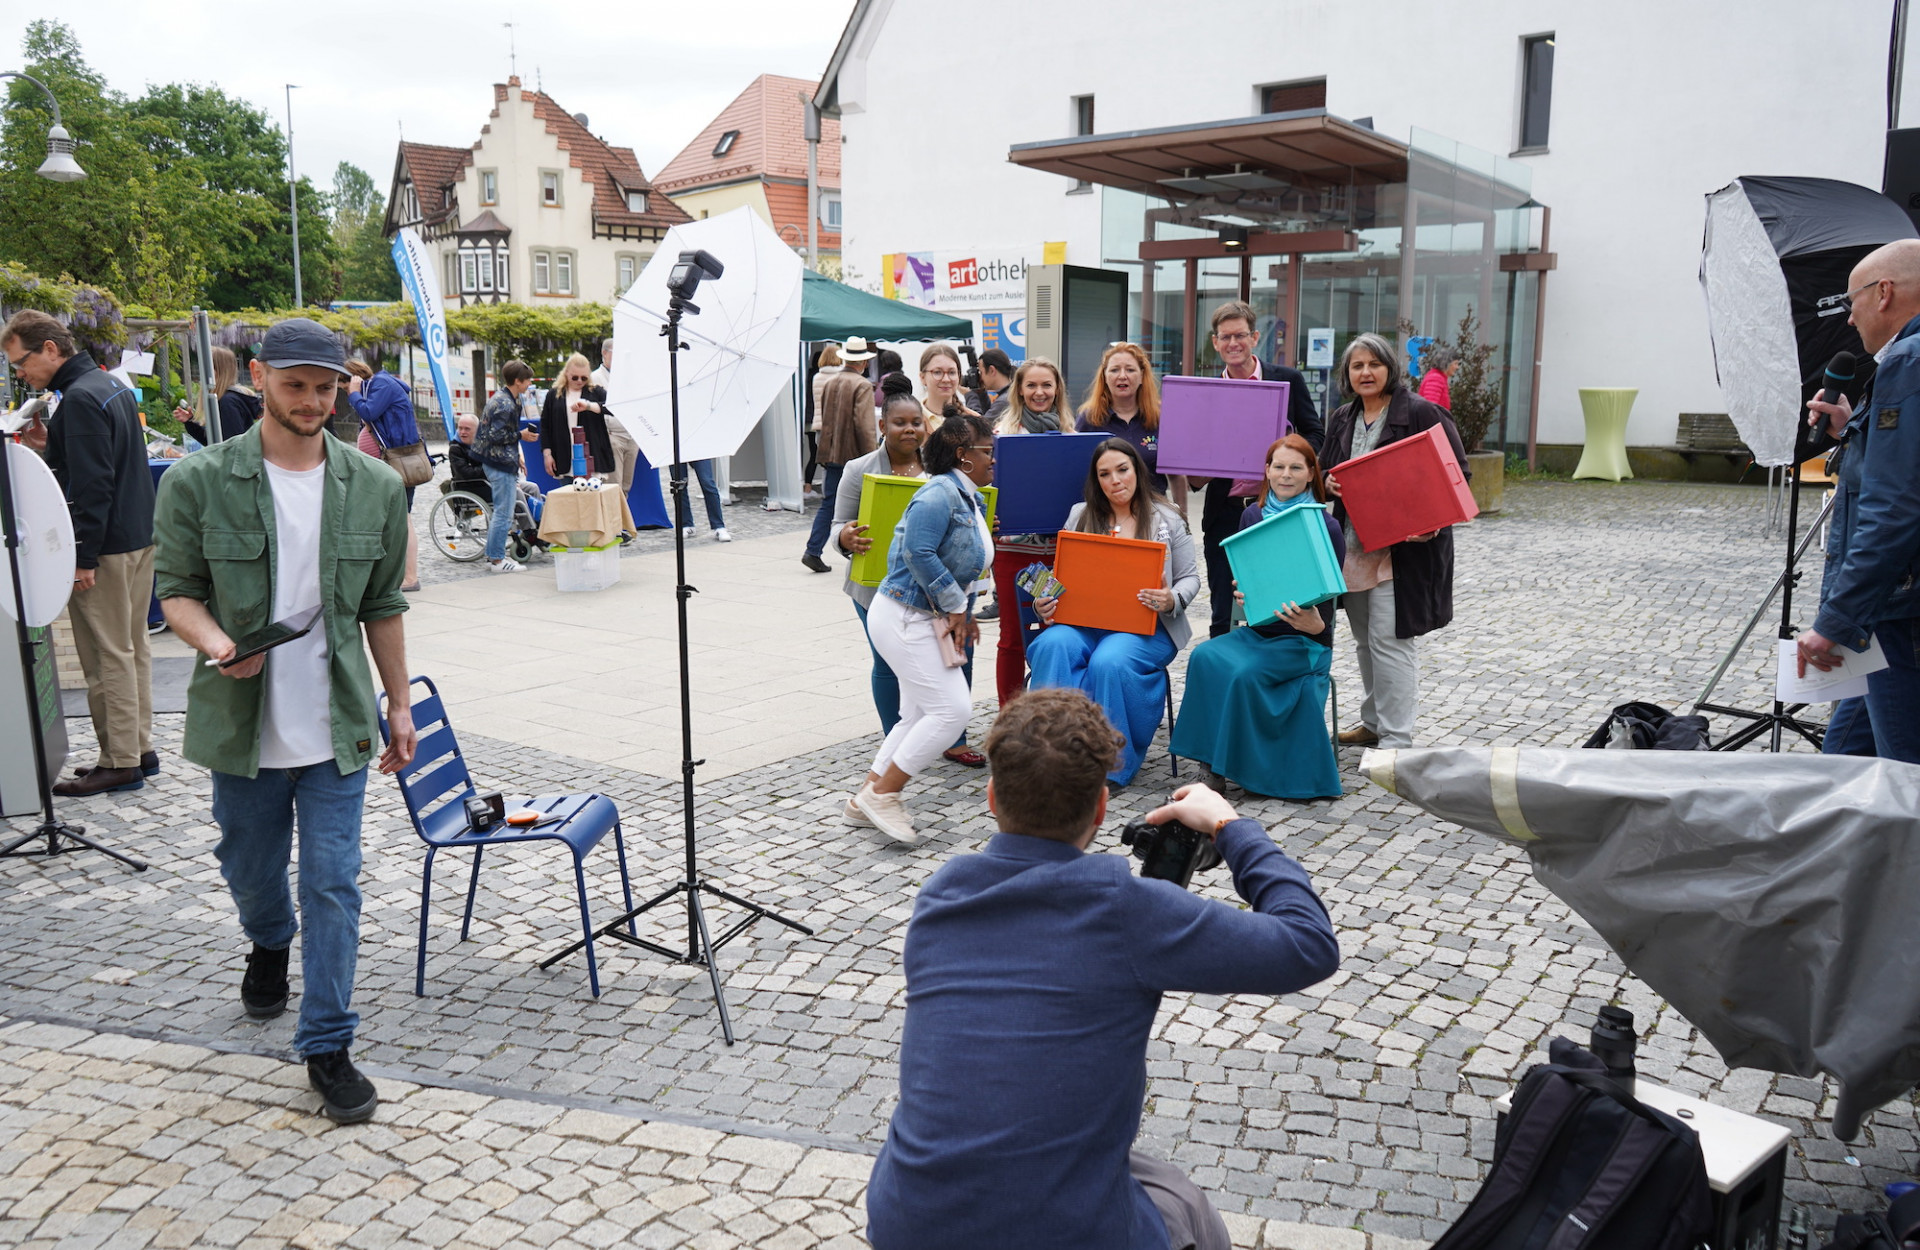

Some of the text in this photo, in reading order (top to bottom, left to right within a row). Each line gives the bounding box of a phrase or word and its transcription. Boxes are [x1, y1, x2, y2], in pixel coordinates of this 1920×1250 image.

[949, 257, 1026, 285] artothek
[939, 294, 968, 303] Moderne
[968, 292, 987, 301] Kunst
